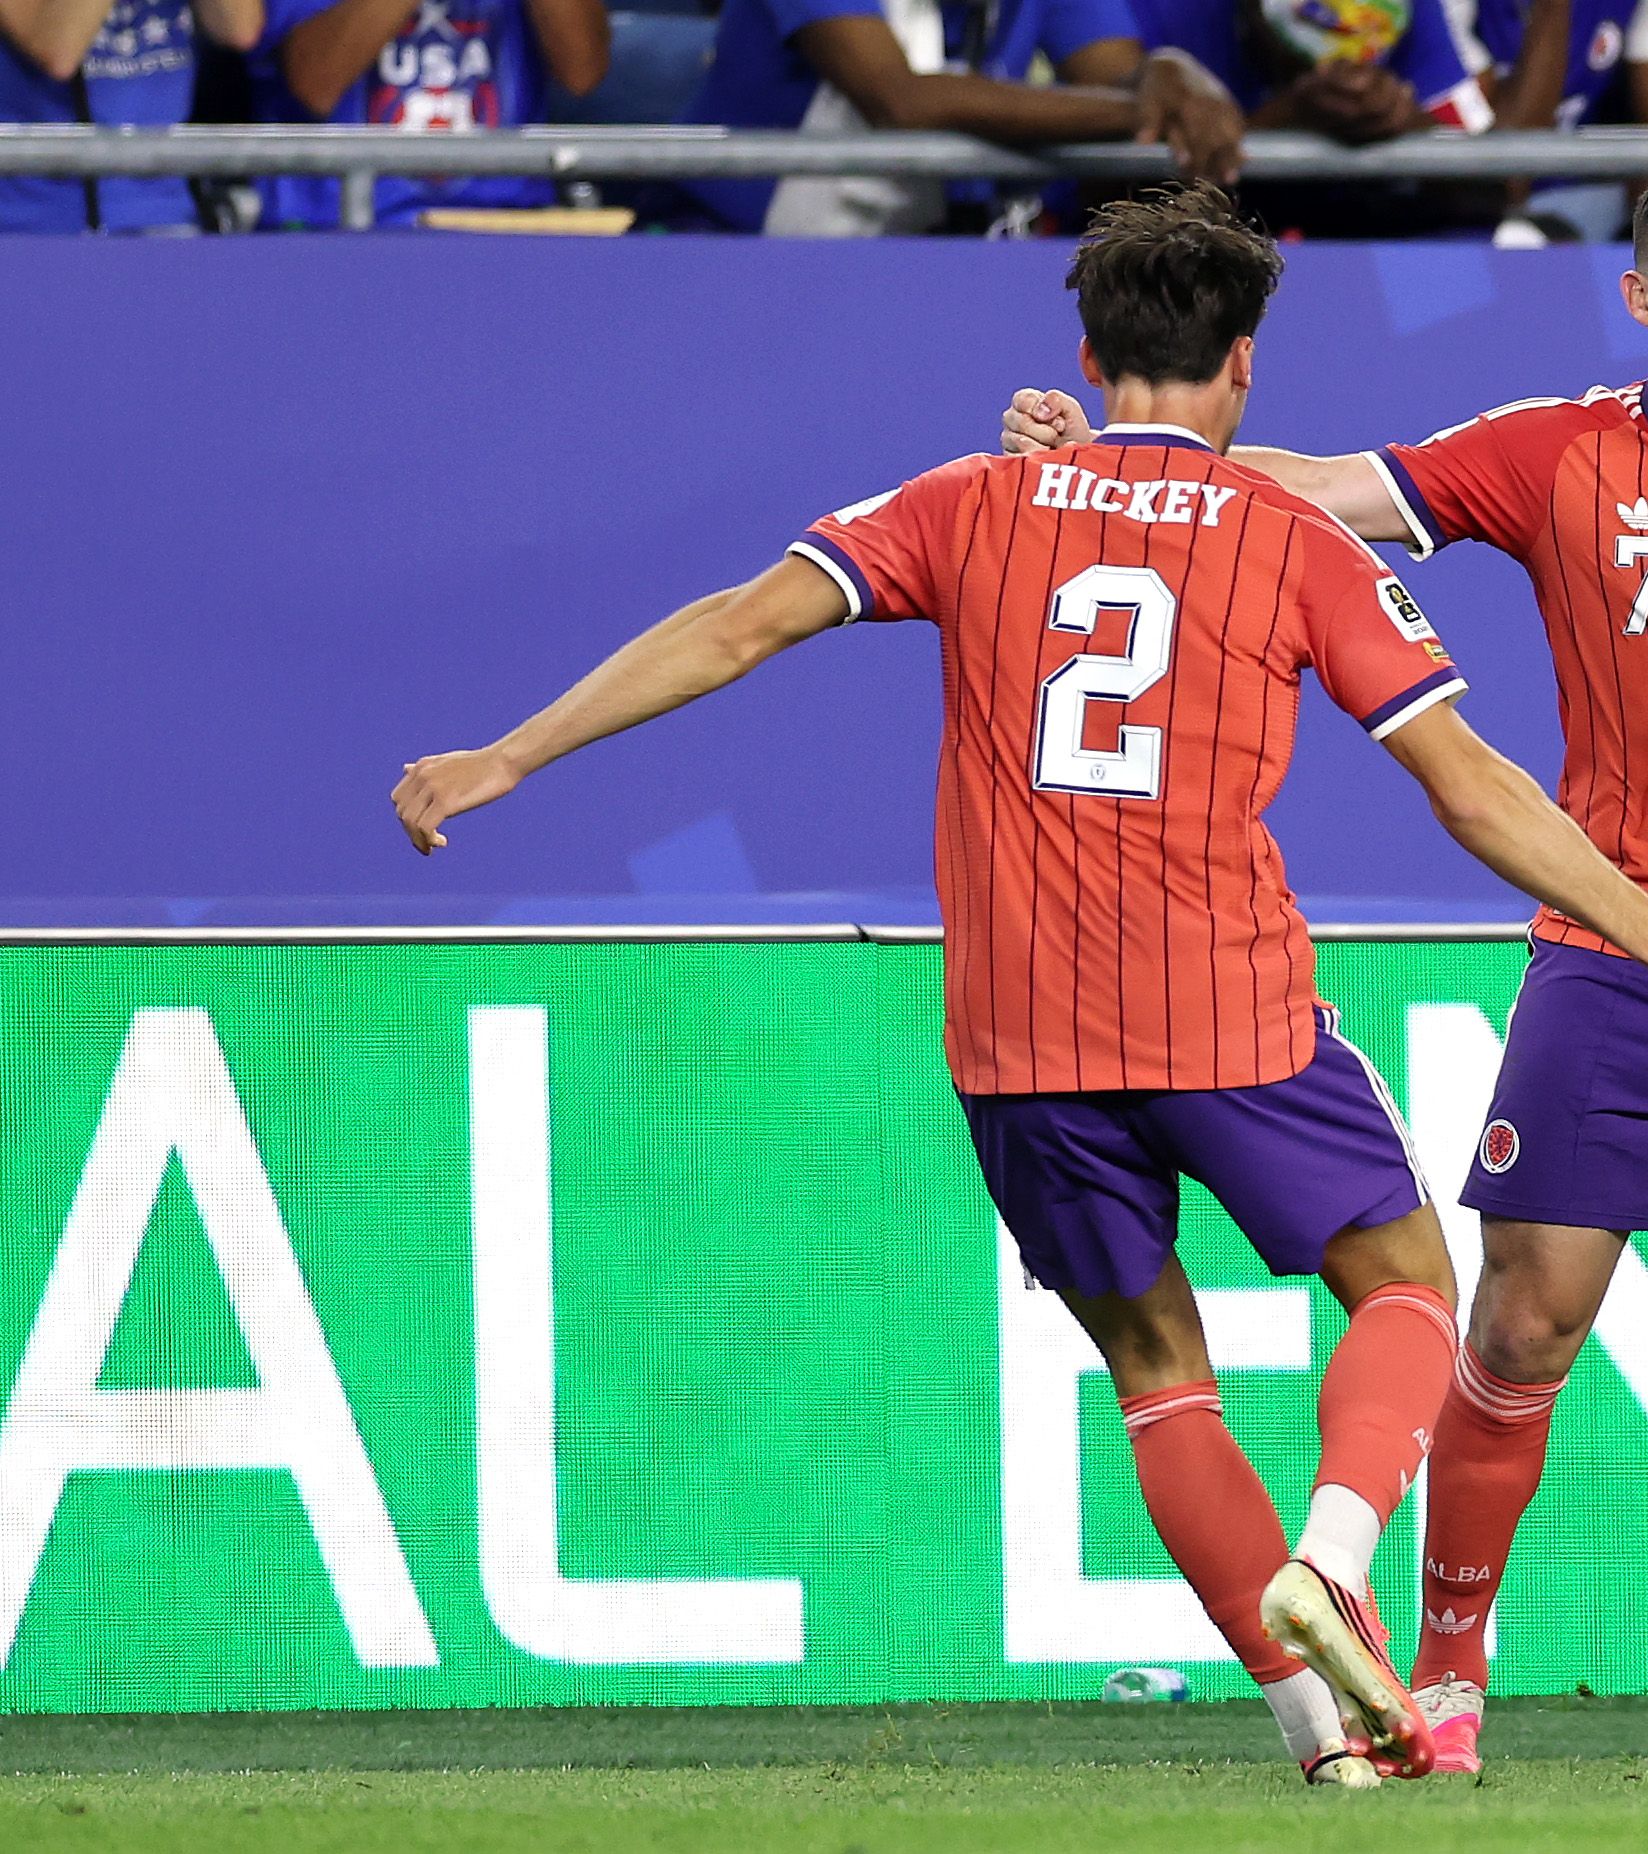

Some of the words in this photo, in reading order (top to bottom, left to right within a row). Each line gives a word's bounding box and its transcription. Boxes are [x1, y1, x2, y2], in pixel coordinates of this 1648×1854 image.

[379, 38, 491, 87] USA
[1031, 462, 1237, 528] HICKEY
[1031, 563, 1178, 802] 2
[0, 1004, 806, 1669] AL
[1426, 1557, 1491, 1583] ALBA
